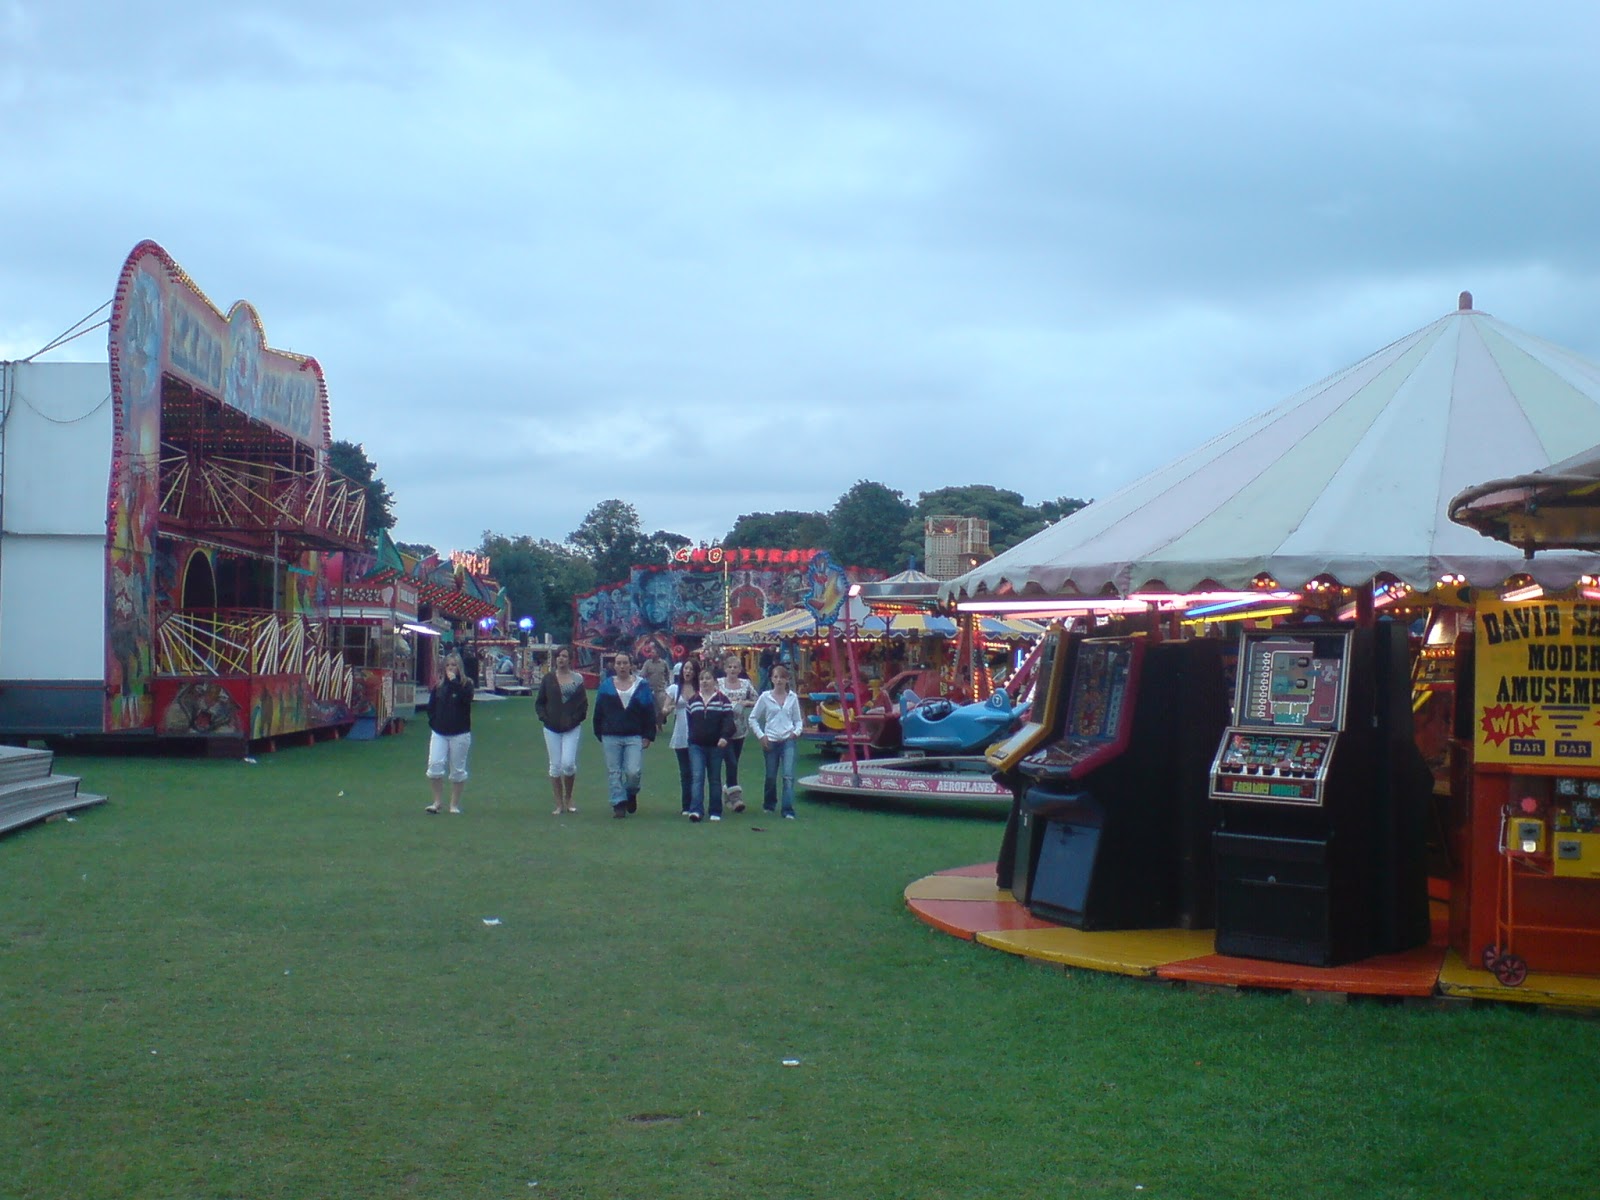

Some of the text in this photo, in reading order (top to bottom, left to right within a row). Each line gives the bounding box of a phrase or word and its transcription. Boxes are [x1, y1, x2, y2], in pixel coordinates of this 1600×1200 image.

[1482, 604, 1560, 645] DAVID
[1491, 710, 1533, 735] WIN
[1513, 743, 1587, 754] BAR BAR
[936, 780, 997, 793] AEROPLANES
